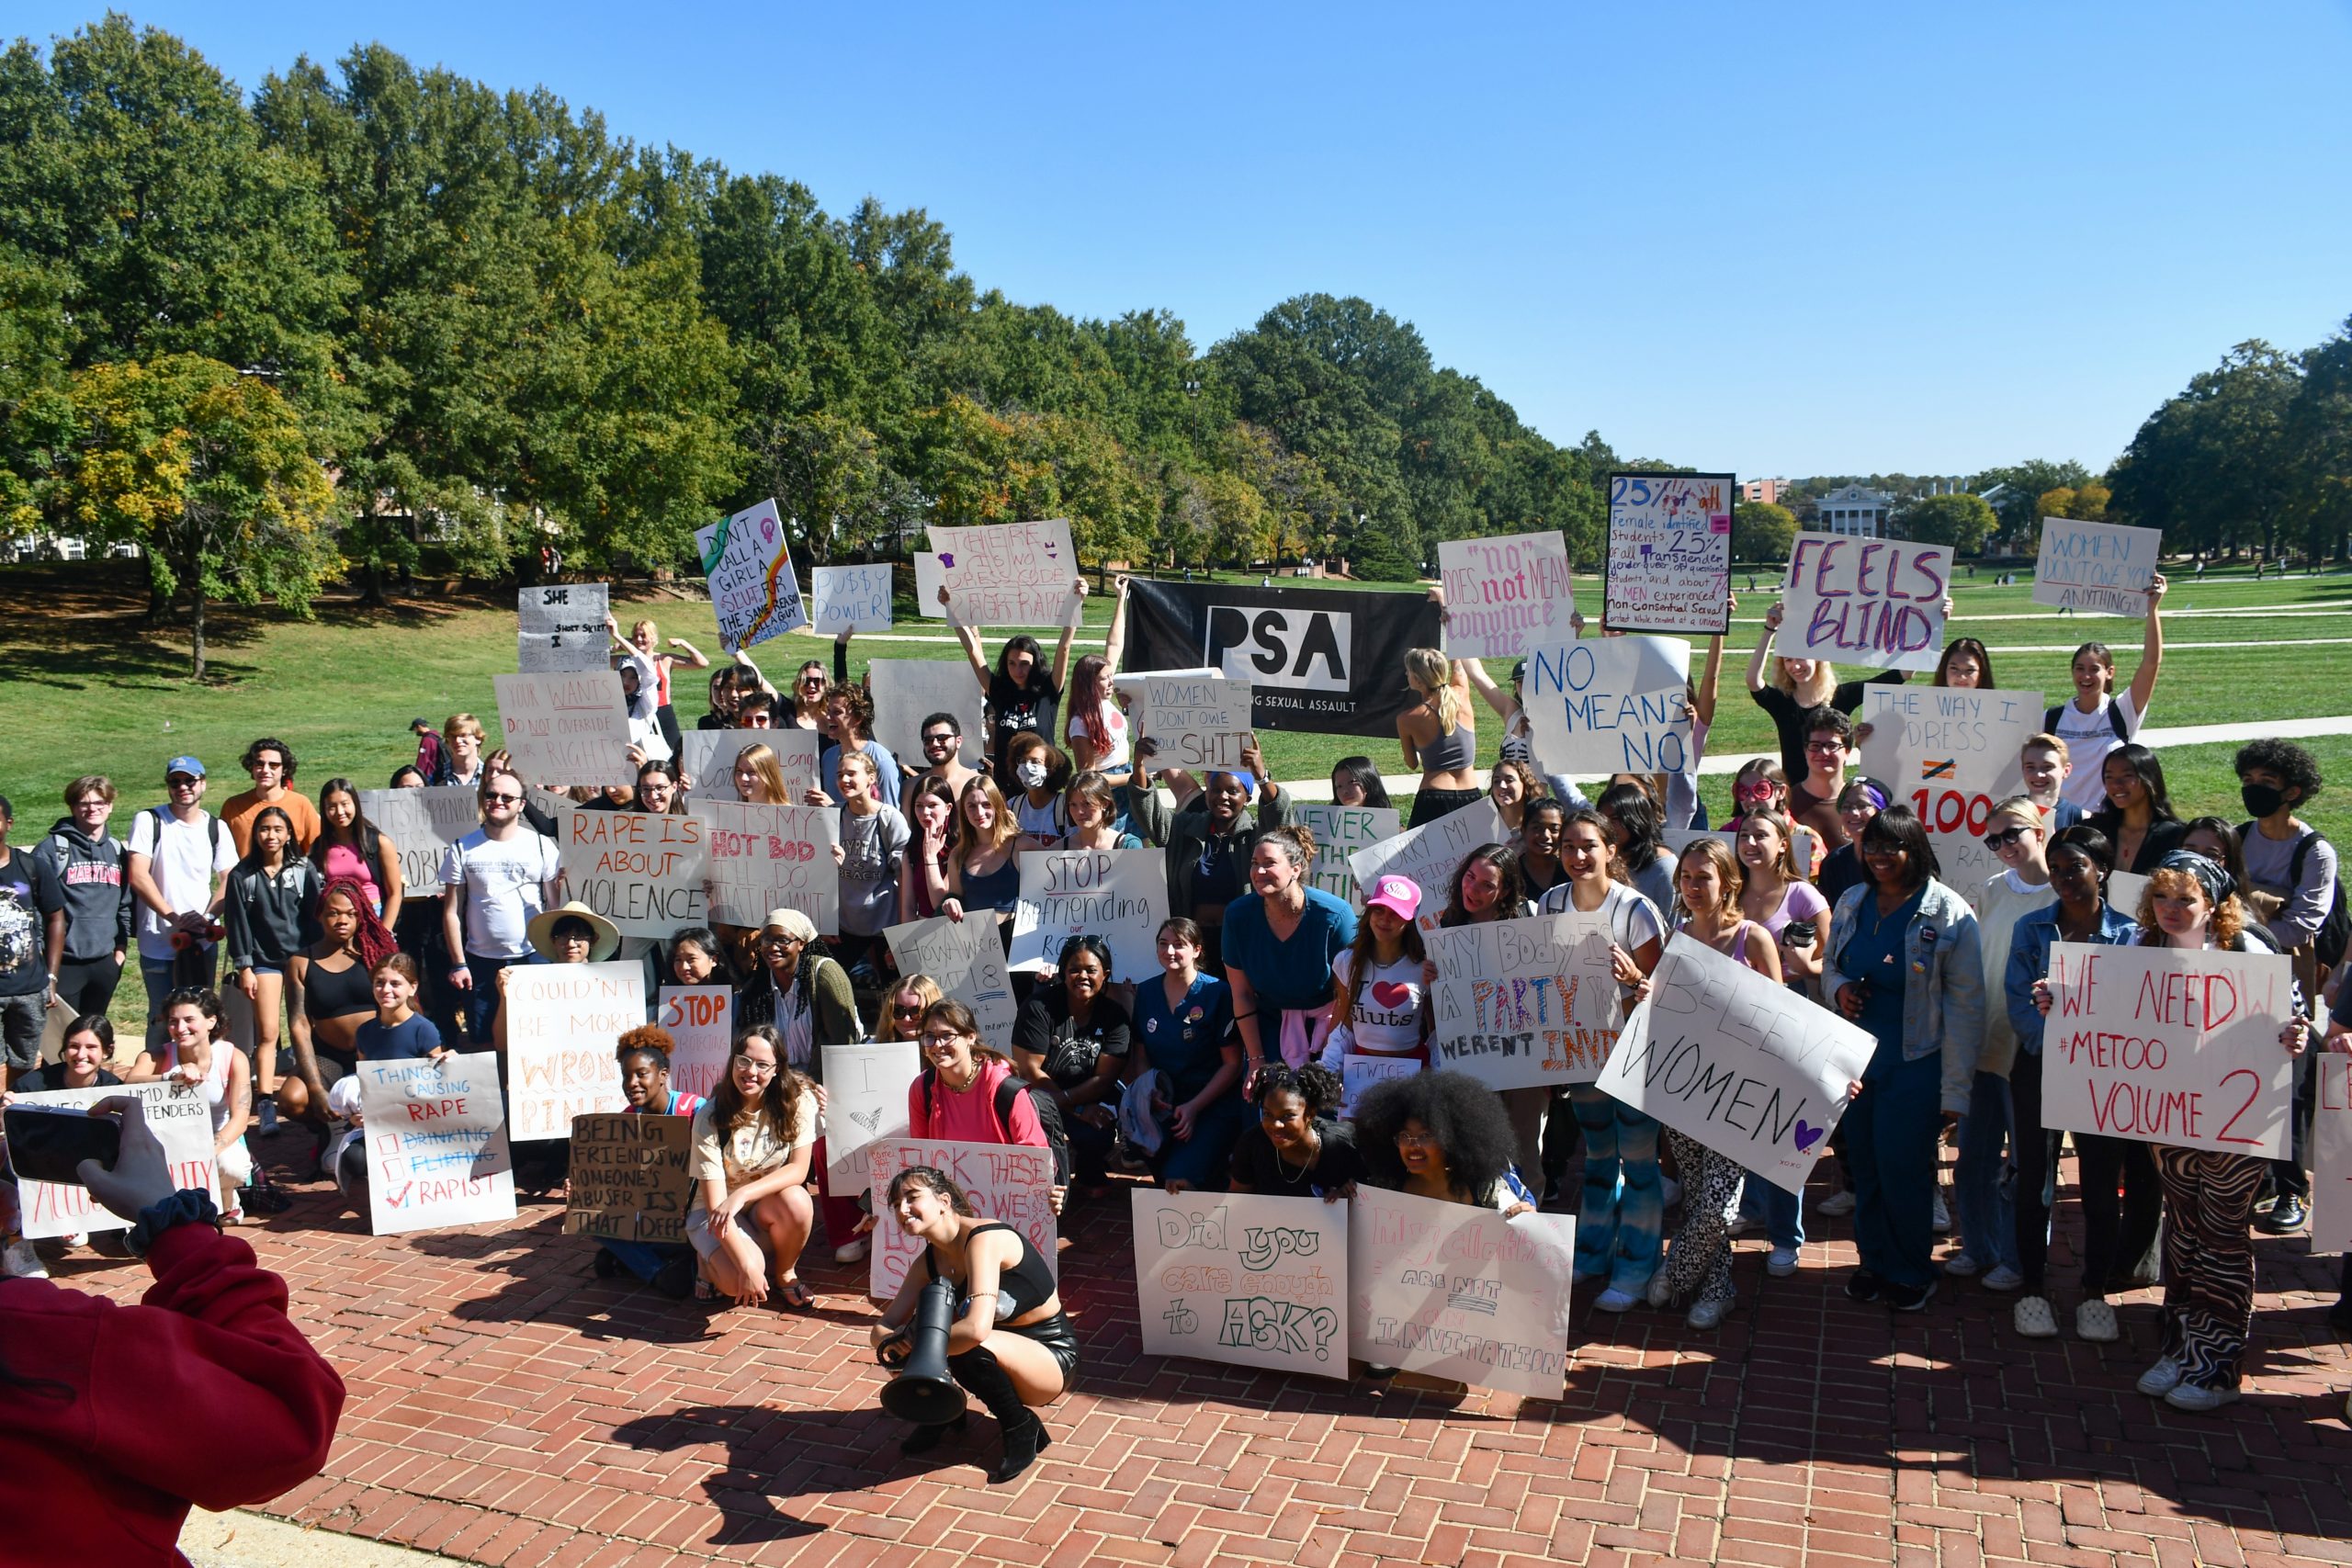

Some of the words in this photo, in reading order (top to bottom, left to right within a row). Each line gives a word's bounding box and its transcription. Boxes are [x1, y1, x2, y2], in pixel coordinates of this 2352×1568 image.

[705, 516, 751, 555] DON'T
[1612, 510, 1656, 530] Female
[944, 524, 1041, 554] THERE
[2051, 530, 2131, 561] WOMEN
[718, 545, 751, 572] CALL
[752, 539, 763, 555] A
[759, 558, 769, 577] A
[1013, 553, 1035, 566] NO
[1791, 539, 1943, 603] FEELS
[762, 575, 786, 601] FOR
[816, 568, 887, 596] PU$$Y
[1018, 568, 1066, 586] CODE
[1443, 567, 1479, 606] DOES
[1481, 569, 1528, 604] not
[1528, 554, 1574, 600] MEAN
[1679, 576, 1710, 587] about
[2091, 563, 2124, 586] OWE
[2127, 566, 2154, 590] YOU
[543, 589, 569, 605] SHE
[816, 589, 891, 623] POWER!
[1623, 587, 1647, 602] MEN
[554, 623, 580, 633] SHORT
[582, 623, 606, 634] SKIRT
[719, 613, 743, 633] THE
[745, 604, 772, 624] SAME
[773, 592, 800, 612] REASON
[727, 628, 747, 648] YOU
[771, 615, 778, 626] A
[777, 606, 797, 623] GUY
[1806, 598, 1931, 654] BLIND
[1208, 607, 1347, 680] PSA
[1535, 646, 1594, 695] NO
[506, 682, 539, 708] YOUR
[547, 678, 613, 707] WANTS
[1148, 681, 1216, 706] WOMEN
[1265, 695, 1303, 710] SEXUAL
[1308, 699, 1357, 714] ASSAULT
[1872, 691, 1920, 716] THE
[1936, 694, 1982, 718] WAY
[1998, 701, 2020, 724] I
[506, 717, 525, 734] DO
[527, 717, 551, 733] NOT
[558, 716, 611, 734] OVERRIDE
[1198, 710, 1229, 726] OWE
[1565, 693, 1689, 733] MEANS
[1181, 731, 1250, 767] SHIT
[1906, 720, 1987, 751] DRESS
[546, 736, 627, 772] RIGHTS
[777, 749, 813, 773] Long
[1623, 732, 1684, 773] NO
[413, 793, 477, 827] HAPPENING
[775, 805, 817, 840] MY
[1294, 809, 1378, 840] NEVER
[573, 814, 647, 846] RAPE
[660, 818, 699, 844] IS
[711, 831, 760, 859] HOT
[768, 833, 816, 863] BOD
[1372, 832, 1430, 876] SORRY
[1442, 817, 1471, 851] MY
[595, 851, 684, 878] ABOUT
[774, 863, 808, 889] DO
[1044, 854, 1112, 892] STOP
[564, 877, 705, 921] VIOLENCE
[1021, 890, 1150, 929] Befriending
[1069, 925, 1084, 933] our
[1430, 928, 1482, 983] MY
[969, 964, 1001, 992] 18
[2060, 953, 2101, 1019] WE
[2134, 969, 2237, 1032] NEED
[668, 994, 726, 1028] STOP
[1441, 983, 1463, 1021] A
[517, 1015, 552, 1037] BE
[571, 1012, 639, 1035] MORE
[1655, 953, 1861, 1085] BELIEVE
[2058, 1031, 2167, 1070] #METOO
[372, 1066, 444, 1086] THINGS
[521, 1049, 616, 1089] WRON
[859, 1057, 878, 1095] I
[1351, 1062, 1407, 1080] TWICE
[1622, 1016, 1807, 1145] WOMEN
[130, 1087, 163, 1102] UMD
[168, 1084, 198, 1100] SEX
[404, 1079, 471, 1099] CAUSING
[407, 1098, 469, 1122] RAPE
[2088, 1078, 2204, 1138] VOLUME
[2216, 1068, 2265, 1146] 2
[576, 1117, 663, 1143] BEING
[573, 1146, 665, 1165] FRIENDS
[978, 1153, 1047, 1186] THESE
[419, 1172, 499, 1205] RAPIST
[571, 1167, 662, 1189] SOMEONE'S
[571, 1190, 634, 1209] ABUSER
[643, 1191, 677, 1213] IS
[991, 1191, 1028, 1221] WE
[573, 1212, 625, 1235] THAT
[639, 1216, 685, 1237] DEEP
[1157, 1205, 1228, 1250] Did
[1238, 1226, 1318, 1271] you
[1161, 1266, 1233, 1294] care
[1240, 1266, 1334, 1308] enough
[1401, 1269, 1446, 1289] ARE
[1453, 1277, 1502, 1300] NOT
[1163, 1298, 1198, 1335] to
[1217, 1296, 1338, 1362] ASK?
[1375, 1317, 1565, 1376] INVITATION
